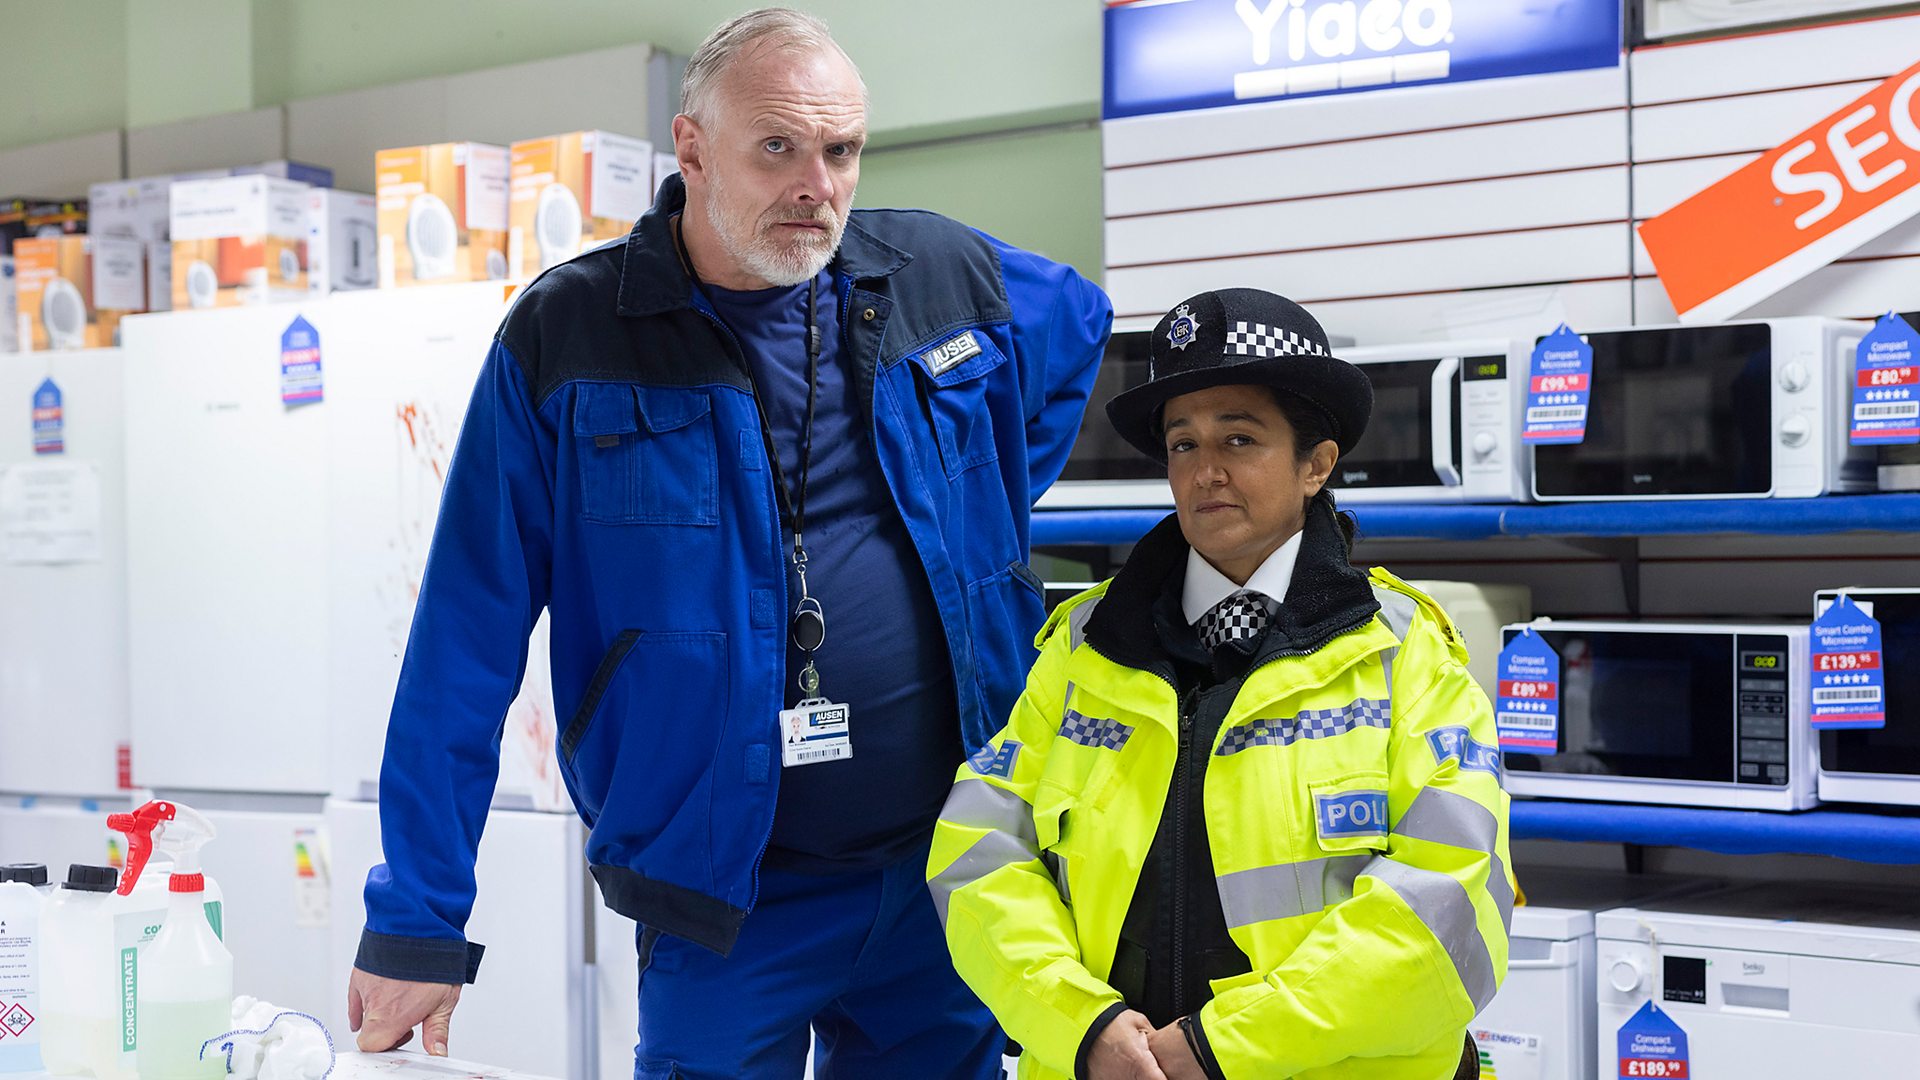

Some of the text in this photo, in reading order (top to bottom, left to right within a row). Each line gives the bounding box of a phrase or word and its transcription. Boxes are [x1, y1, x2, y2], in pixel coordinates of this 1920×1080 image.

[1871, 341, 1908, 353] Compact
[1544, 350, 1579, 362] Compact
[1867, 351, 1911, 362] Microwave
[1540, 360, 1582, 370] Microwave
[1815, 624, 1874, 636] Smart Combo
[1821, 636, 1868, 646] Microwave
[1511, 654, 1545, 666] Compact
[1508, 664, 1548, 675] Microwave
[125, 951, 135, 1046] CONCENTRATE
[1635, 1033, 1671, 1046] Compact
[1631, 1043, 1676, 1054] Dishwasher
[1628, 1060, 1680, 1076] £189.99
